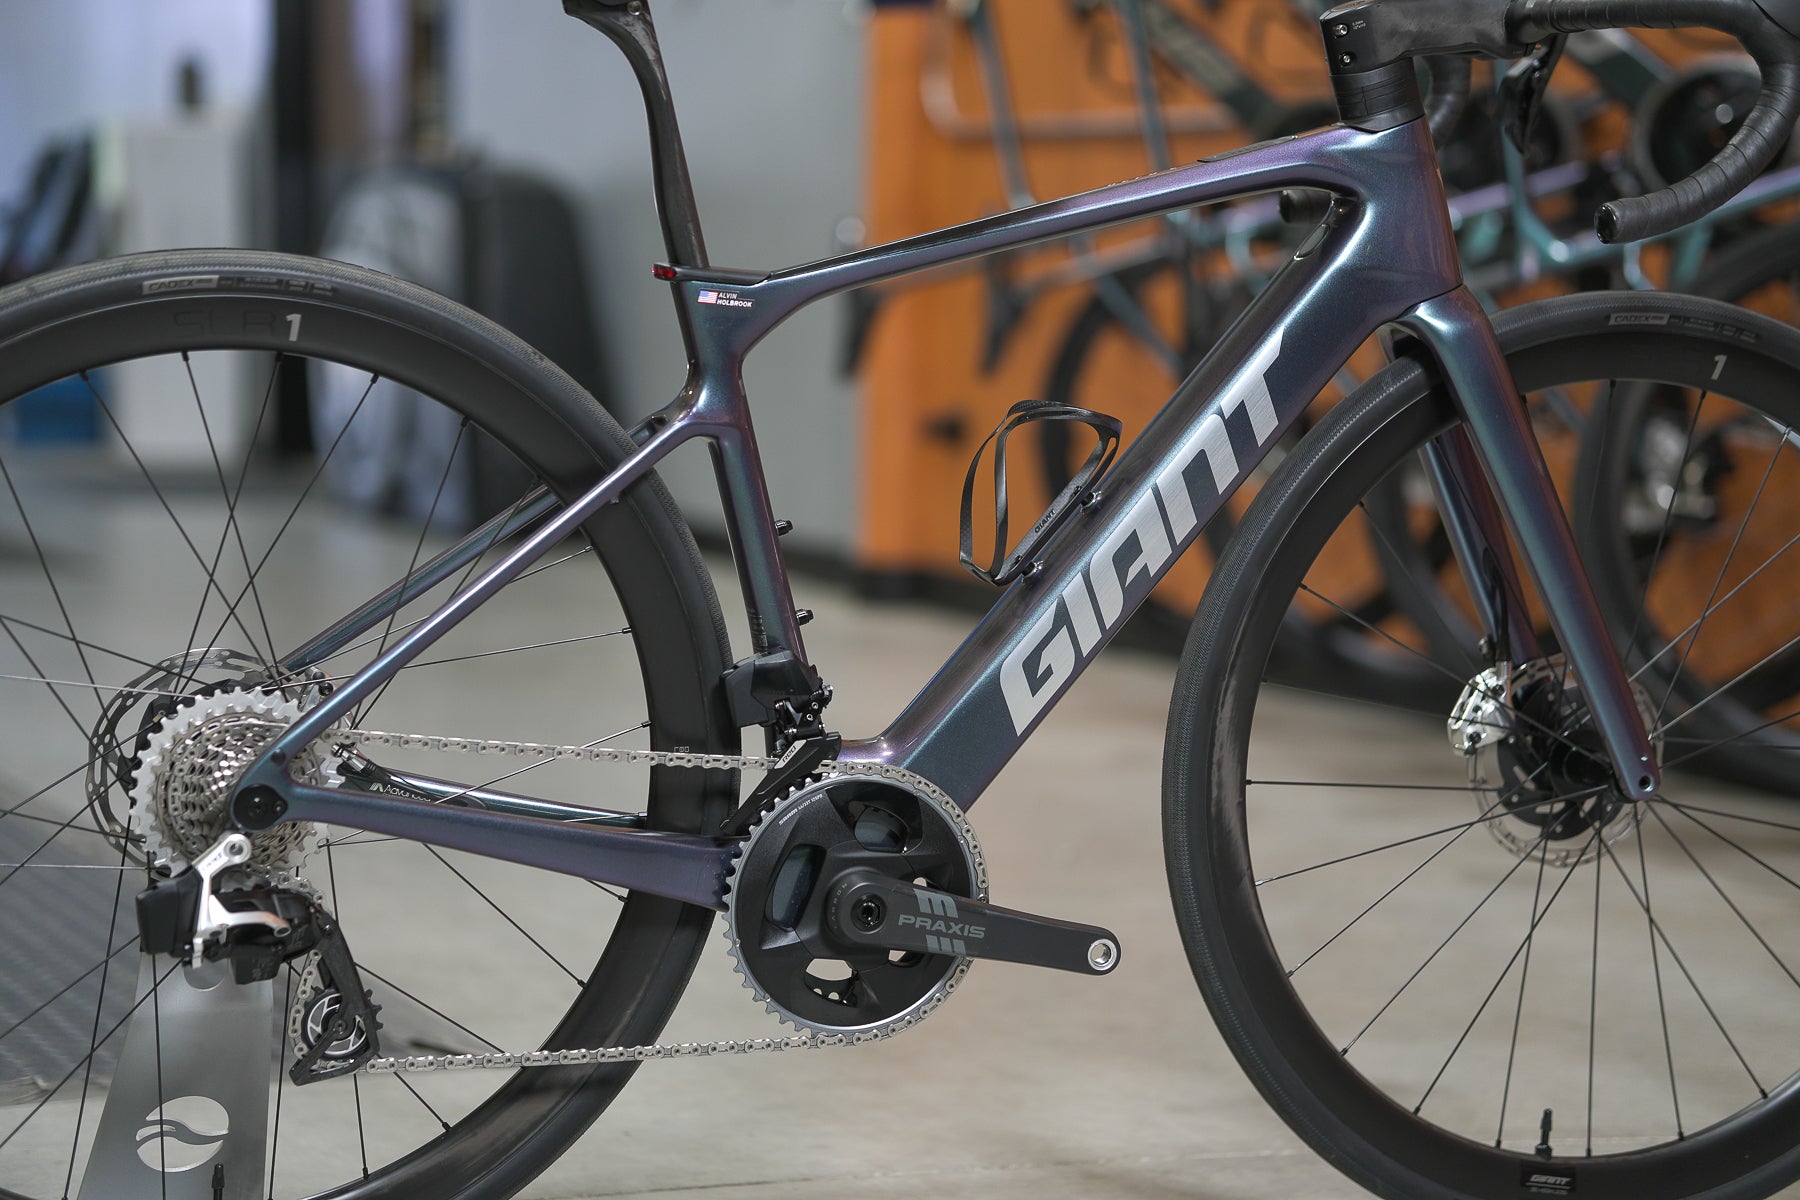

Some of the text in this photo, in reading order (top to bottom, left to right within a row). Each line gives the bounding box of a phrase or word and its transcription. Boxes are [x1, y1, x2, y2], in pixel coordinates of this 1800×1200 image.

[149, 278, 195, 291] CADEX
[718, 292, 738, 300] ALVIN
[716, 299, 753, 308] HOLBROOK
[286, 313, 302, 342] 1
[1711, 354, 1728, 381] 1
[1000, 325, 1285, 737] GIANT
[1034, 508, 1056, 533] GIANT
[898, 914, 986, 939] PRAXIS
